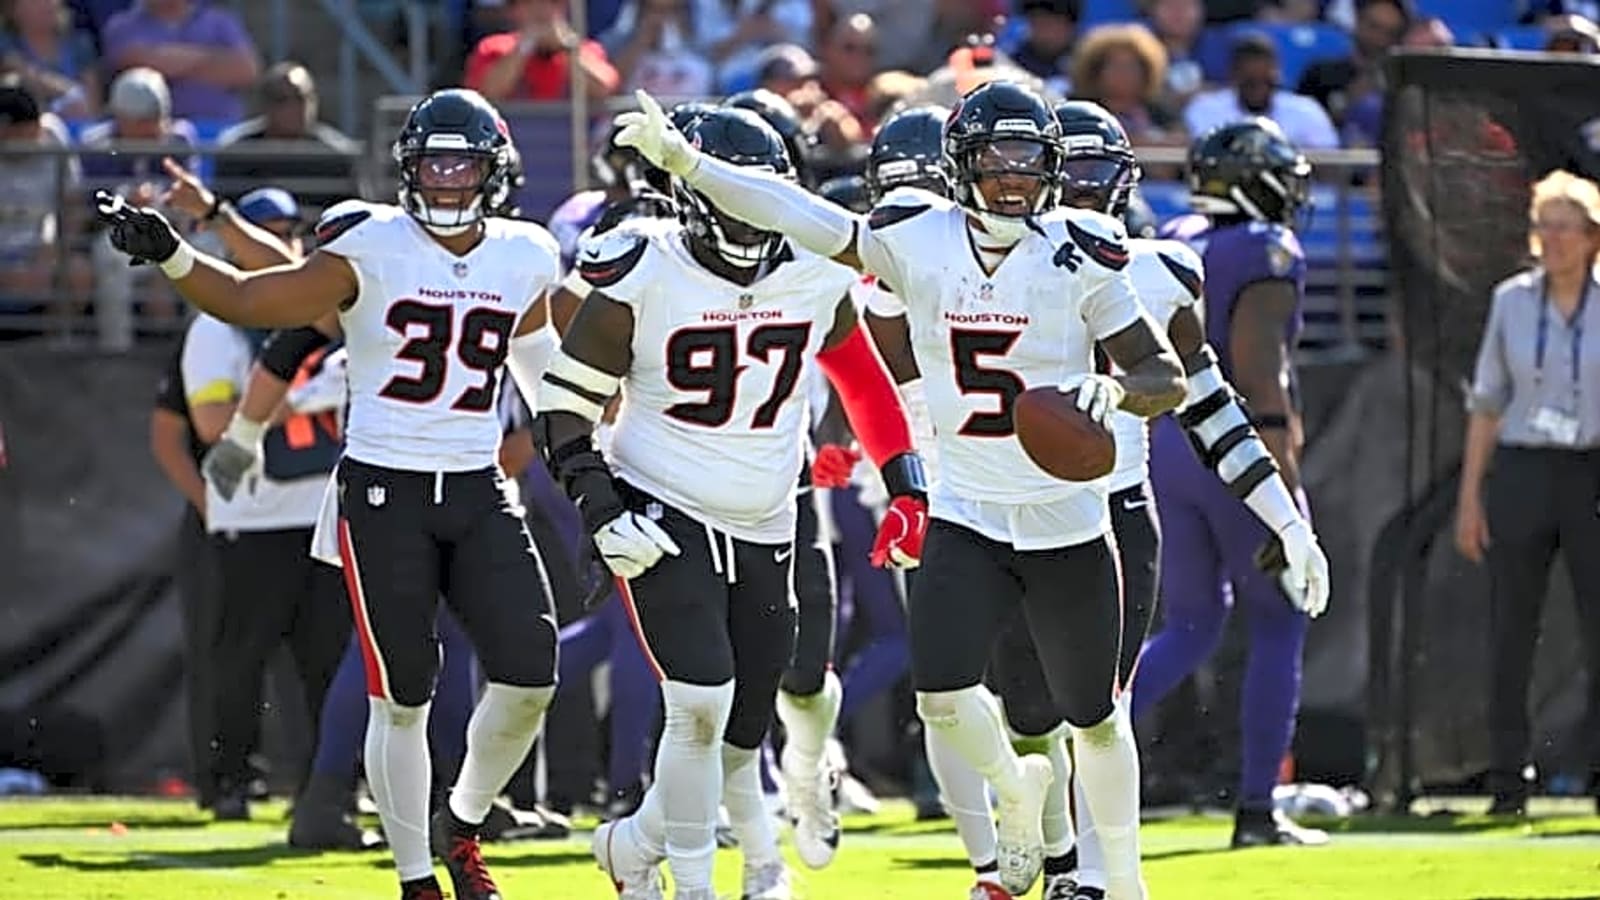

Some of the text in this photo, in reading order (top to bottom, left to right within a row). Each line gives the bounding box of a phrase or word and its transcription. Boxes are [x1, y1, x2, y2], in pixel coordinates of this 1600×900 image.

[418, 287, 503, 303] HOUSTON
[702, 309, 783, 322] HOUSTON
[944, 311, 1030, 325] HOUSTON
[378, 298, 518, 413] 39
[662, 320, 813, 429] 97
[949, 326, 1027, 438] 5
